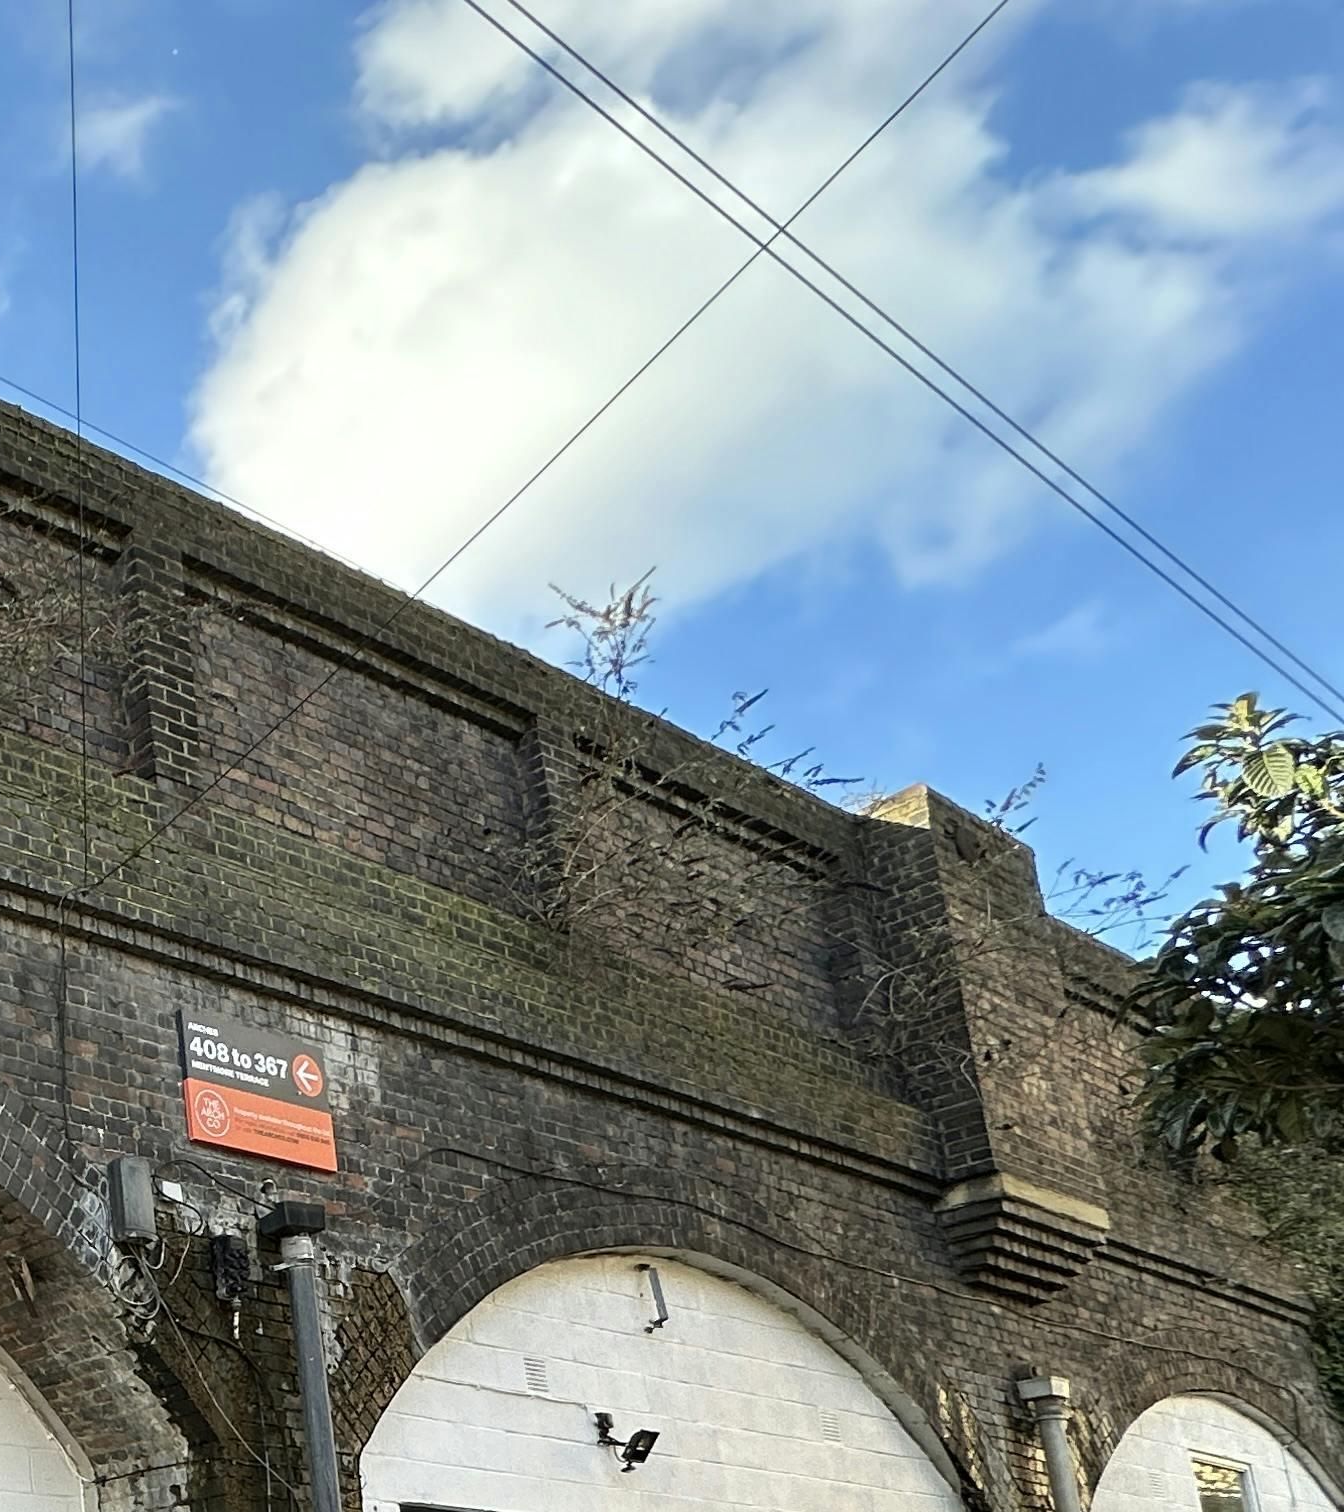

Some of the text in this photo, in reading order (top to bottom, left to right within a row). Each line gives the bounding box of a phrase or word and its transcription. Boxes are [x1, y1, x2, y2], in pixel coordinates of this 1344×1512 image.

[188, 1022, 219, 1037] ARCHES
[189, 1036, 289, 1079] 408 to 367
[235, 1071, 270, 1087] TERRACE
[203, 1097, 221, 1111] THE
[201, 1107, 225, 1121] ARCH
[206, 1118, 221, 1129] CO
